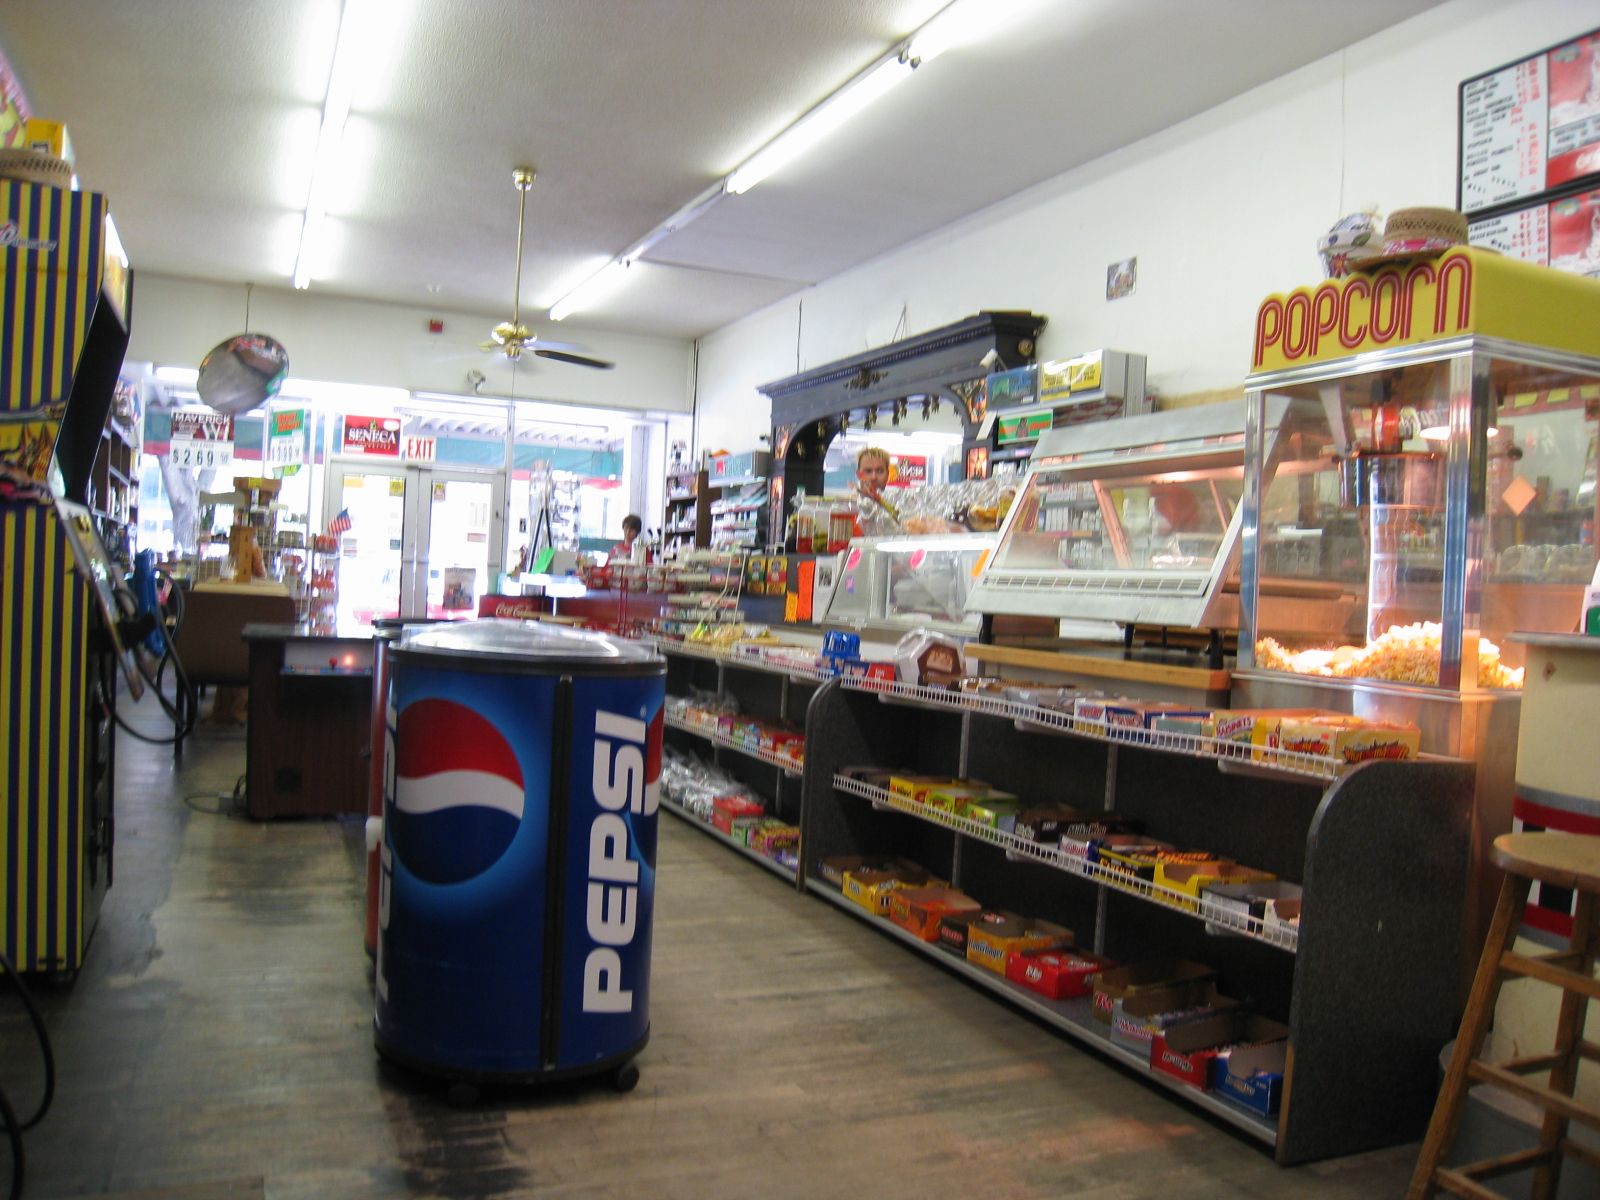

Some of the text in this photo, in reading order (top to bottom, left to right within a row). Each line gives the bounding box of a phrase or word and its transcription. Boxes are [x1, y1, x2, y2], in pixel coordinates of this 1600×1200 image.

[175, 412, 231, 425] MAVERICK
[348, 428, 396, 444] SENECA
[407, 437, 434, 460] EXIT
[583, 709, 647, 1013] PEPSI
